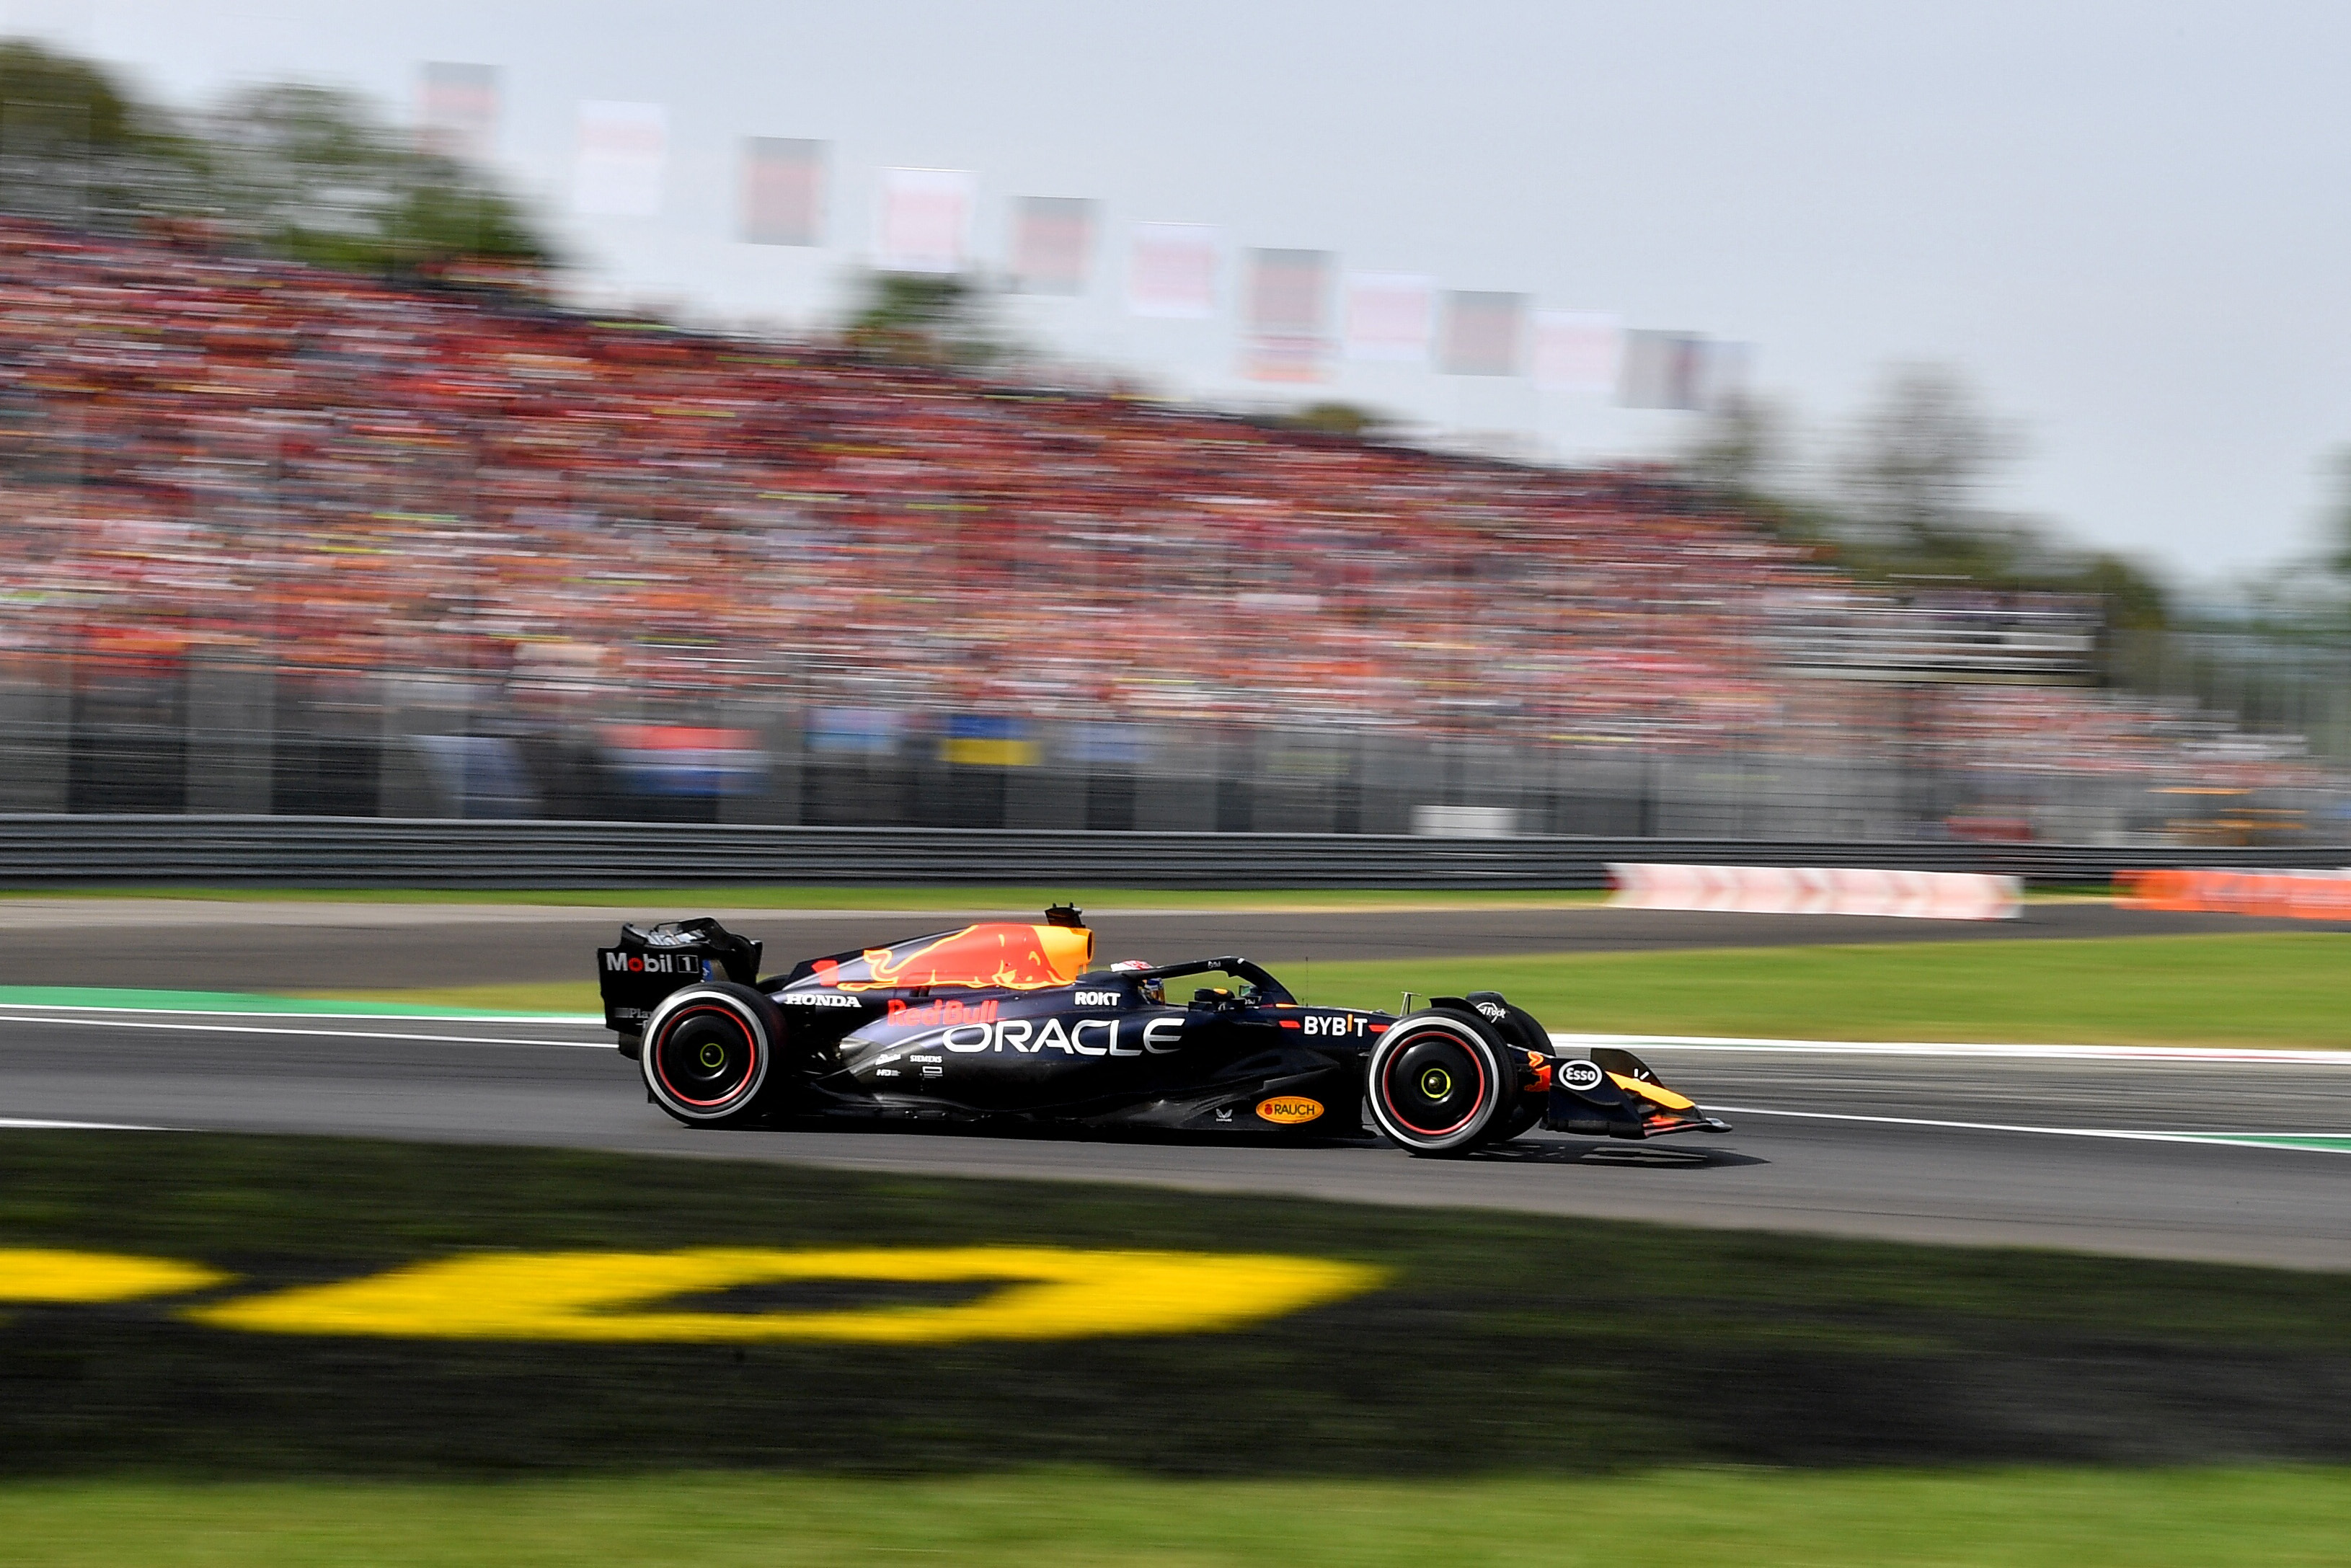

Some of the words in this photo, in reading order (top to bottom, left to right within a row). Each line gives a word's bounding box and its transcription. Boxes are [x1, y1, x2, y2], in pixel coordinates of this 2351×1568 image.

[606, 952, 673, 973] Mobil
[682, 957, 691, 971] 1
[811, 960, 838, 986] 1
[784, 993, 862, 1008] HONDA
[1074, 991, 1121, 1006] ROKT
[1303, 1014, 1368, 1037] BYBIT
[942, 1018, 1186, 1057] ORACLE
[909, 1055, 943, 1063] SIEMENS
[1565, 1067, 1597, 1081] Esso
[1274, 1104, 1316, 1116] RAUCH
